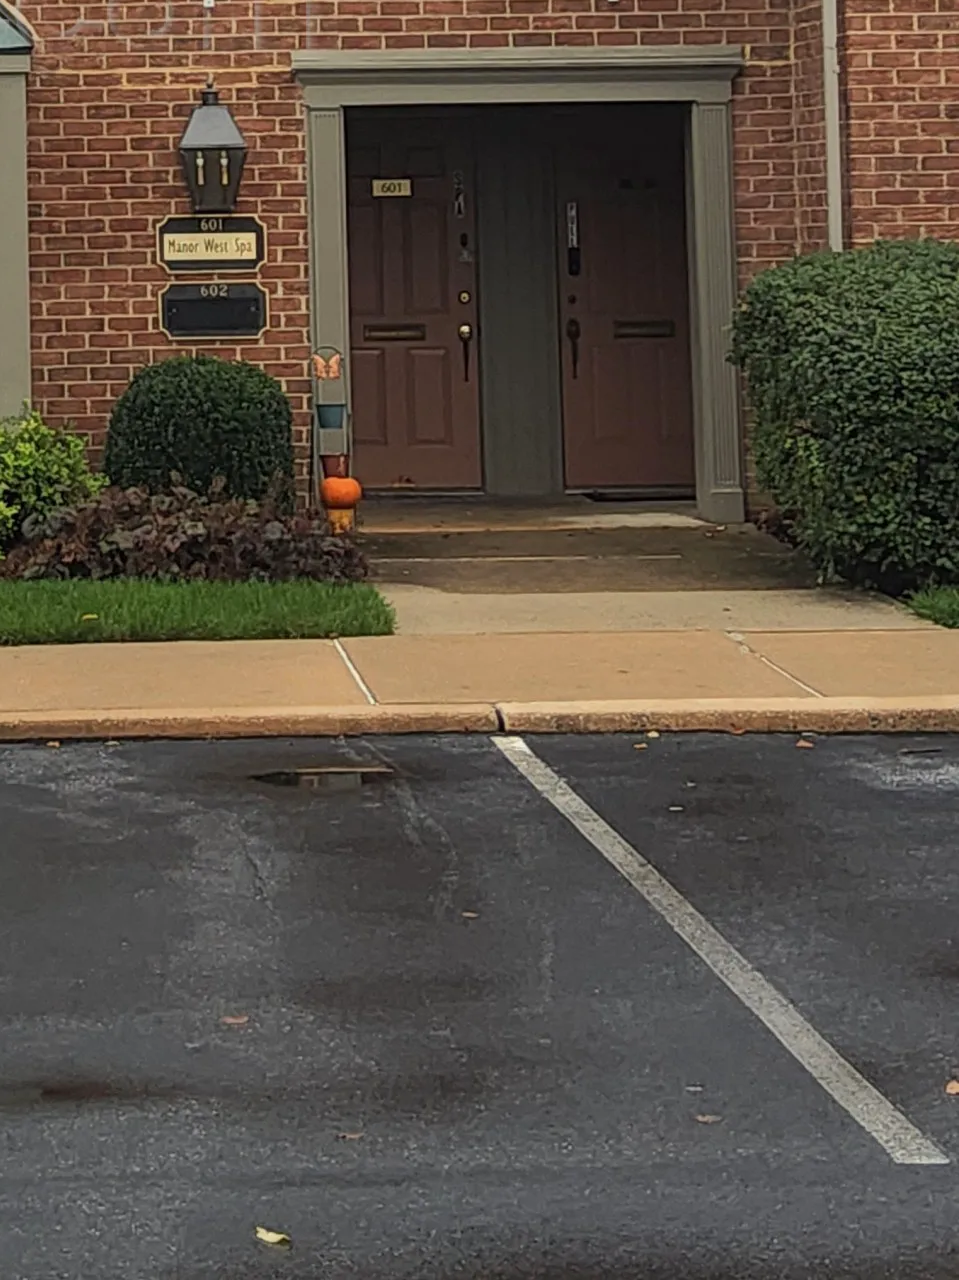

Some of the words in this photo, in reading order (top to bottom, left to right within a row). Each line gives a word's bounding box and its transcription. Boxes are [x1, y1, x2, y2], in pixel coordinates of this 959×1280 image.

[380, 182, 403, 194] 601
[201, 219, 223, 231] 601
[169, 239, 200, 254] Manor
[205, 238, 229, 253] West
[235, 238, 253, 256] Spa
[200, 285, 228, 297] 602
